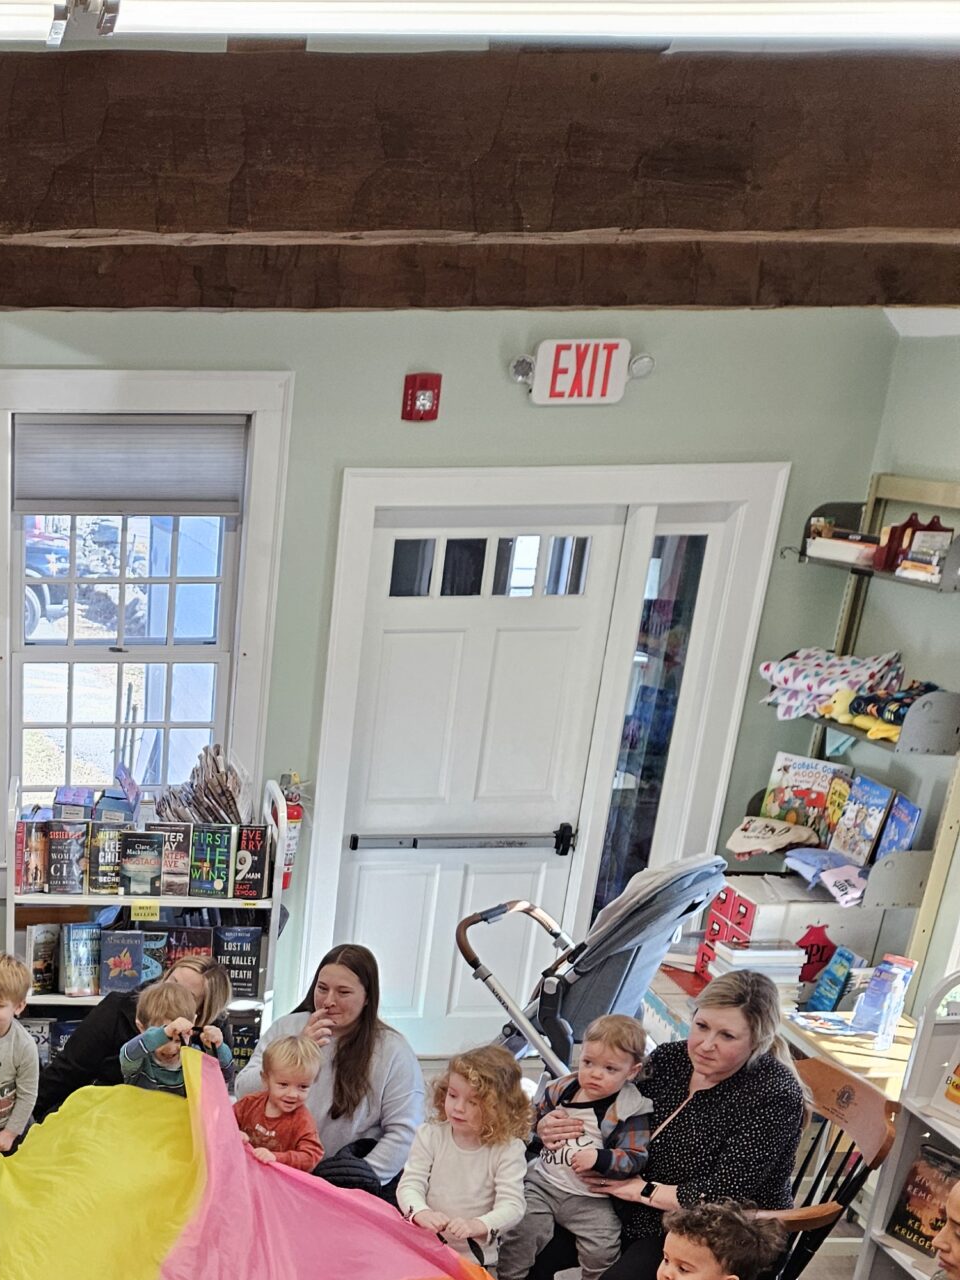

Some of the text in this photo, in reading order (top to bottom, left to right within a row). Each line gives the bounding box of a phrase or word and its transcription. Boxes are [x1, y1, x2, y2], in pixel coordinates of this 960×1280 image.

[548, 343, 620, 399] EXIT
[165, 832, 184, 842] TER
[192, 833, 229, 844] FIRST
[241, 830, 262, 840] EVE
[104, 842, 121, 852] LEE
[240, 841, 263, 851] RRY
[99, 853, 121, 863] CHIL
[164, 851, 186, 859] NTER
[192, 847, 228, 868] LIE
[50, 863, 82, 876] CIA
[235, 850, 252, 881] 9
[191, 869, 227, 882] WINS
[224, 942, 251, 951] LOST IN
[218, 955, 257, 966] THE VALLEY
[230, 970, 252, 979] DEATH
